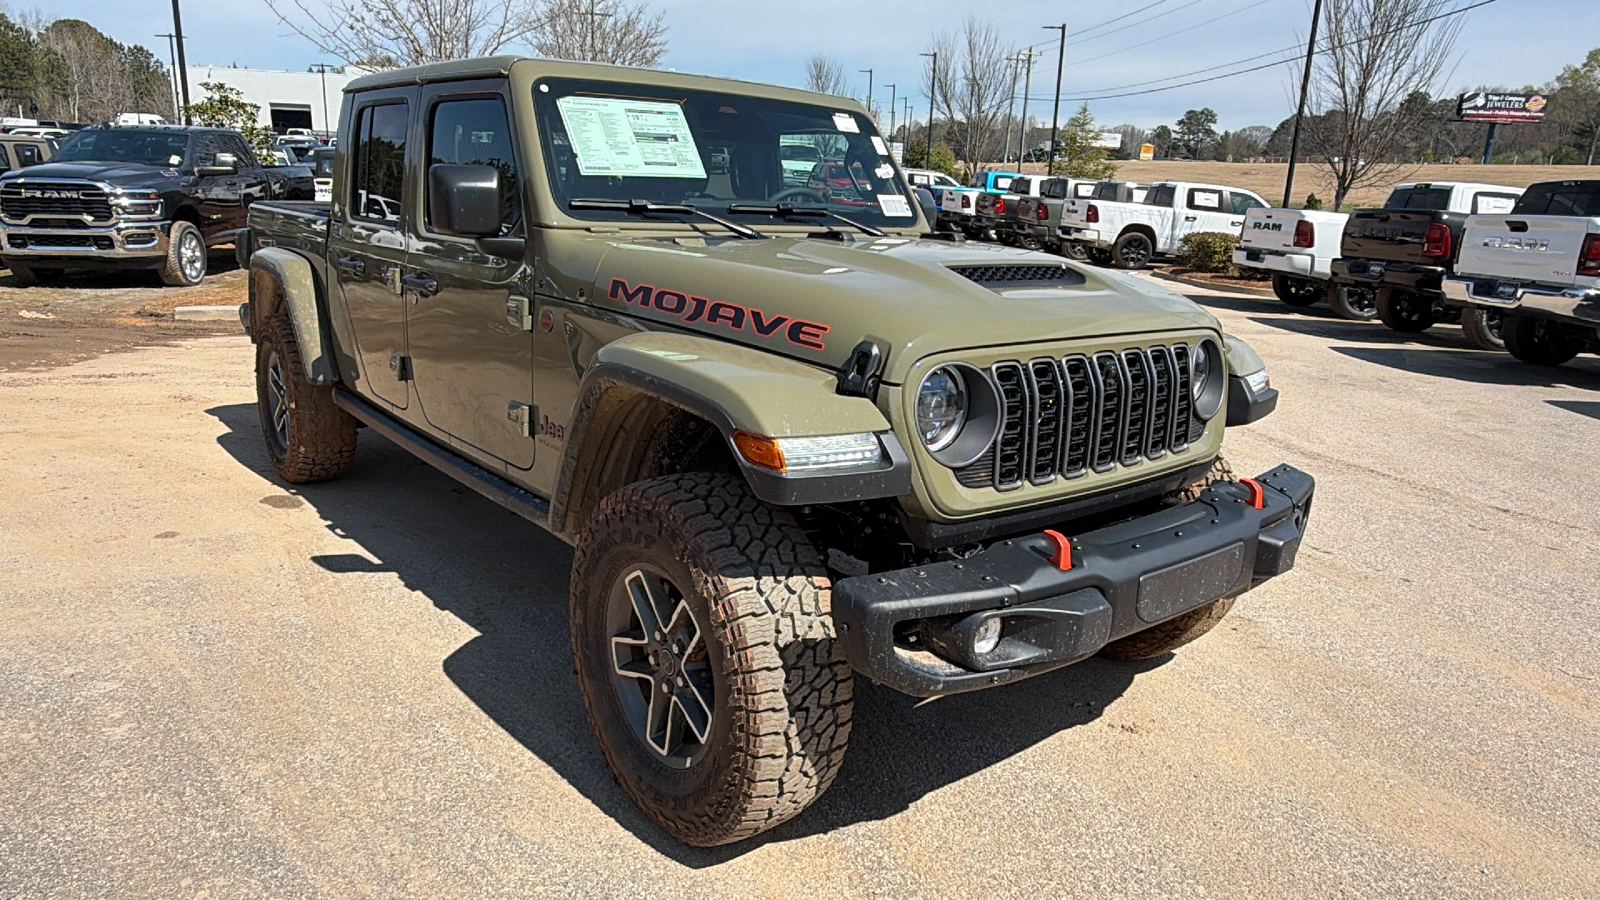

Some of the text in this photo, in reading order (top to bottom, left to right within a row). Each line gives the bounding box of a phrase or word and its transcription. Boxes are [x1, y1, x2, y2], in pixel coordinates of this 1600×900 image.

[24, 190, 79, 199] RAM
[1253, 222, 1282, 231] RAM
[1482, 237, 1549, 251] RAM
[608, 277, 830, 351] MOJAVE
[538, 414, 564, 441] Jee
